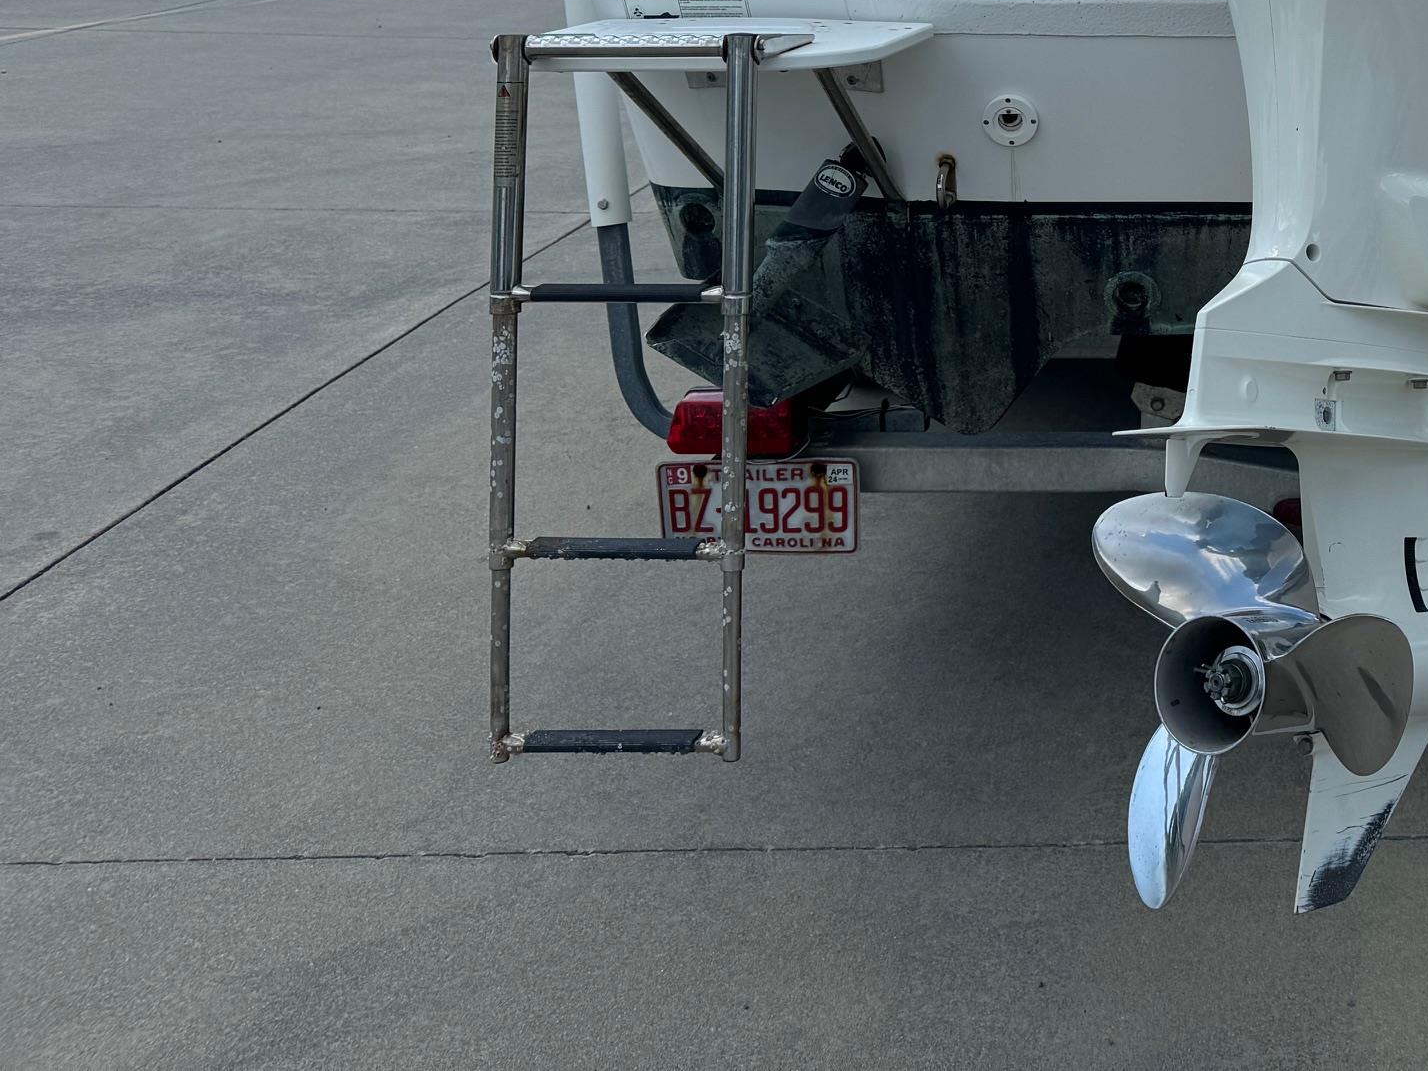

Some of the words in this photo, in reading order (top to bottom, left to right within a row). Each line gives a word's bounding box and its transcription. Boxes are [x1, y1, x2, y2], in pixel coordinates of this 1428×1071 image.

[819, 173, 848, 193] LENCO
[676, 467, 689, 484] 9
[708, 468, 804, 482] TAILER
[830, 468, 849, 476] APR
[828, 475, 838, 483] 24
[752, 536, 846, 548] CAROLINA
